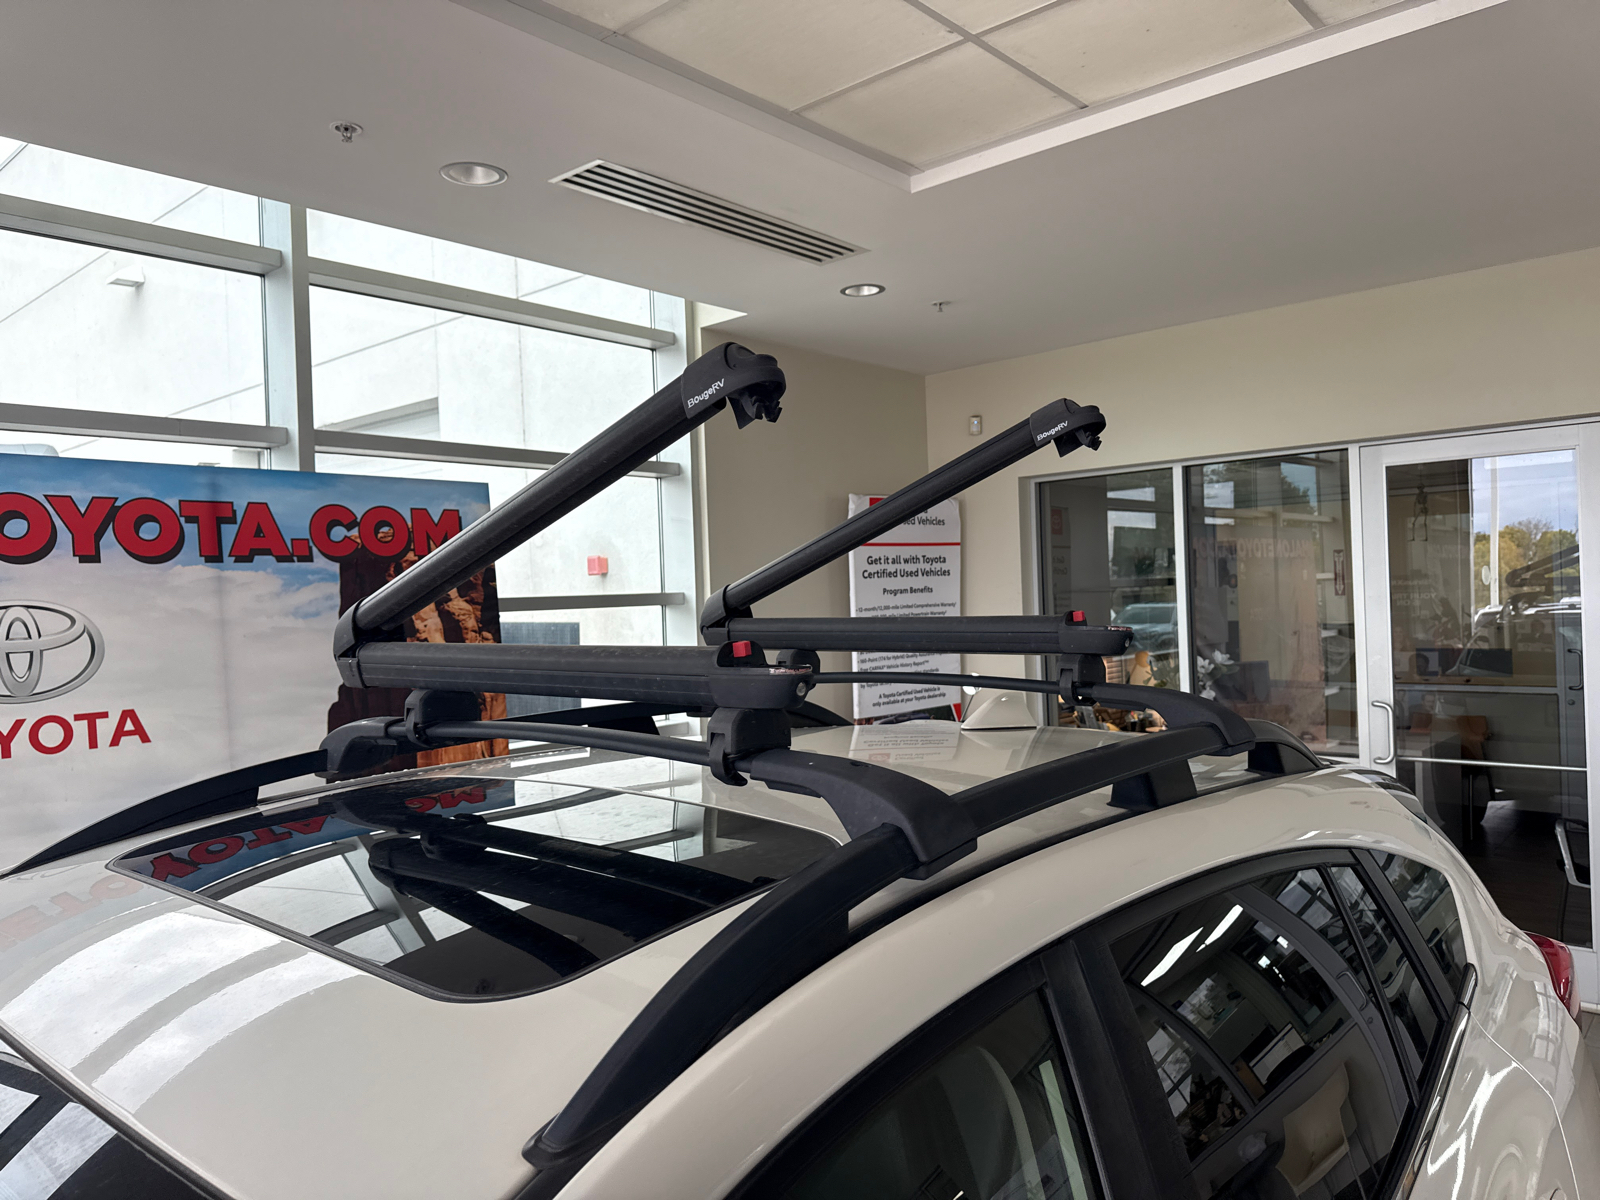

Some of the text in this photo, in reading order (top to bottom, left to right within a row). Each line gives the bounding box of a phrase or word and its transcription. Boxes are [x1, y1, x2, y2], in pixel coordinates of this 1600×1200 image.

[687, 378, 725, 409] BougeRV
[1036, 420, 1068, 442] BougeRV
[917, 516, 945, 526] Vehicles
[866, 555, 947, 566] Get it all with Toyota
[862, 567, 951, 579] Certified Used Vehicles
[882, 586, 933, 597] Program Benefits
[896, 689, 913, 697] Certified
[882, 698, 899, 706] available
